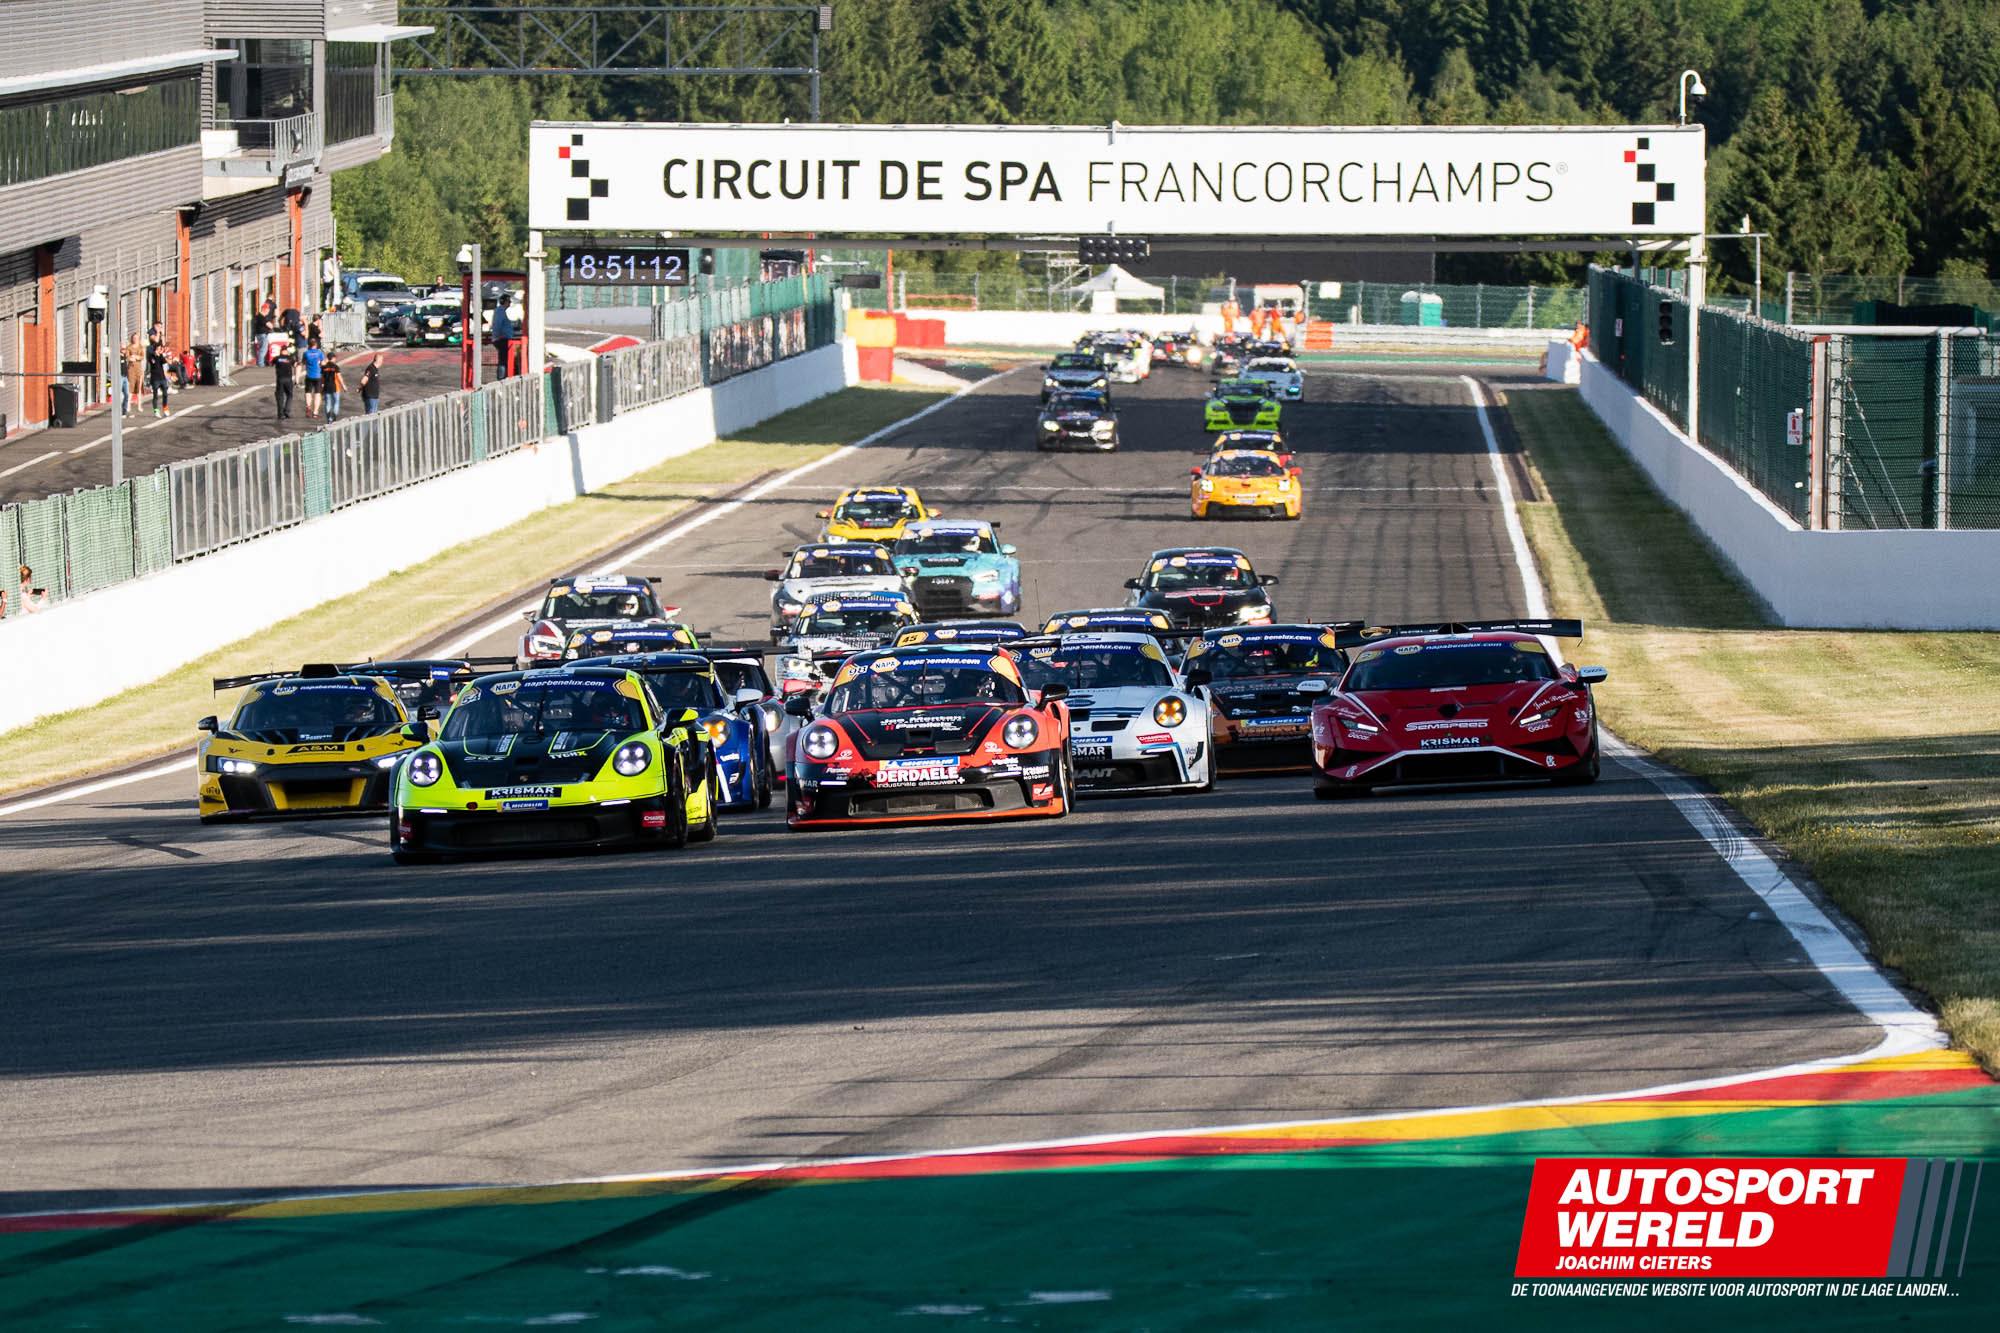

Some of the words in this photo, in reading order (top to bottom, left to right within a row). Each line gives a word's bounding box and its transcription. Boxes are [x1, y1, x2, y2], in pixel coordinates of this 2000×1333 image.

[663, 157, 860, 201] CIRCUIT
[880, 159, 943, 201] DE
[964, 160, 1062, 202] SPA
[564, 254, 682, 281] 18:51:12
[1397, 646, 1419, 654] NAPA
[875, 661, 896, 669] NAPA
[494, 683, 517, 692] NAPA
[1420, 736, 1480, 747] KRISMAR
[1072, 746, 1105, 756] SMAR
[876, 766, 960, 783] DERDAELE
[491, 786, 555, 796] KRISMAR
